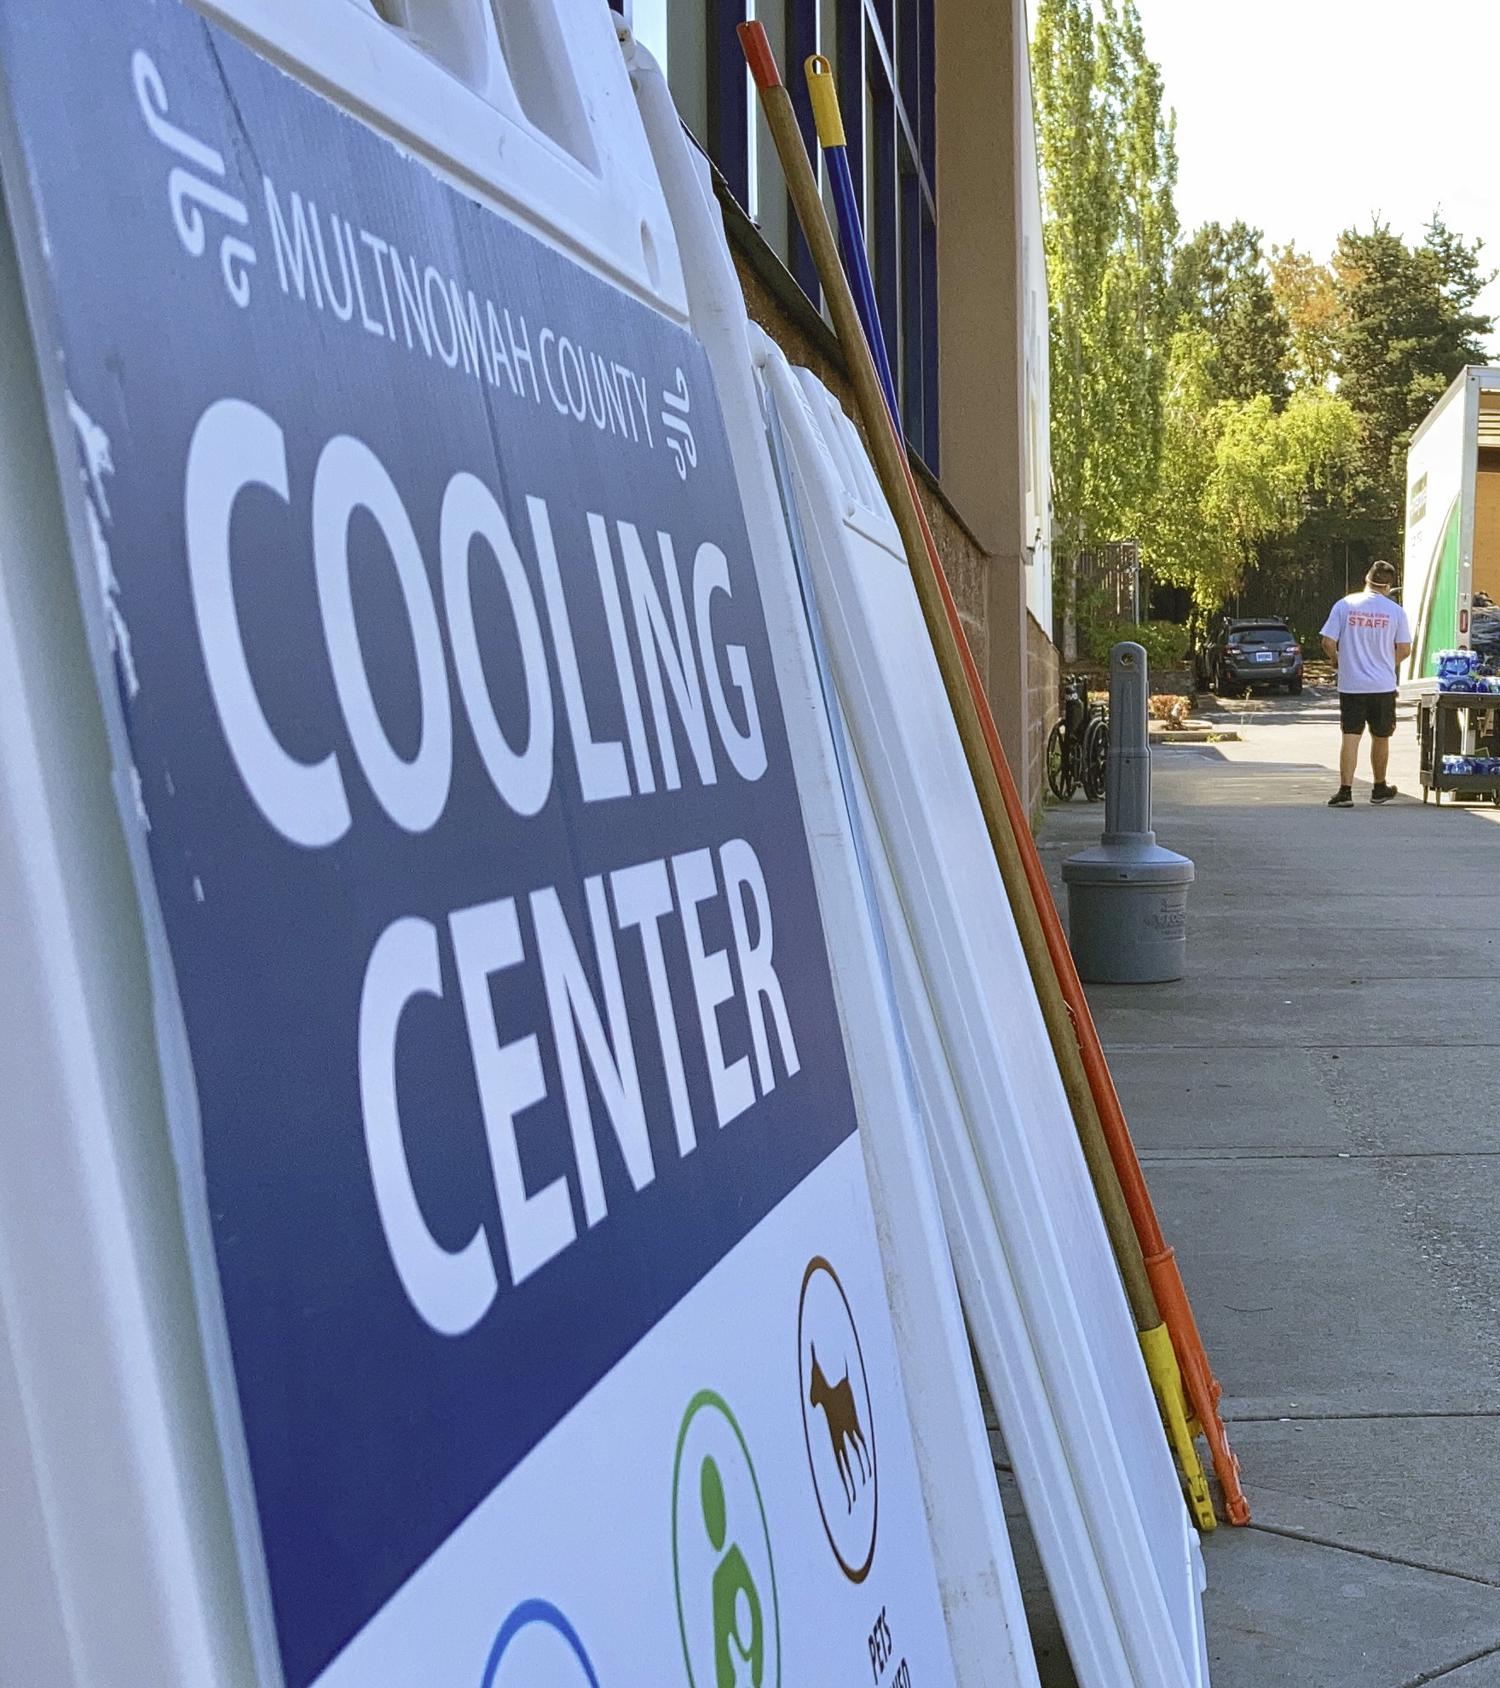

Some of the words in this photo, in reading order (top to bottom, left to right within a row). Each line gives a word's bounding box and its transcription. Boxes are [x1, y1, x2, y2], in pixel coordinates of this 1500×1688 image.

[262, 177, 541, 404] MULTNOMAH
[538, 327, 655, 448] COUNTY
[184, 398, 768, 848] COOLING
[1348, 616, 1389, 628] STAFF
[357, 838, 801, 1337] CENTER
[868, 1605, 892, 1686] PETS
